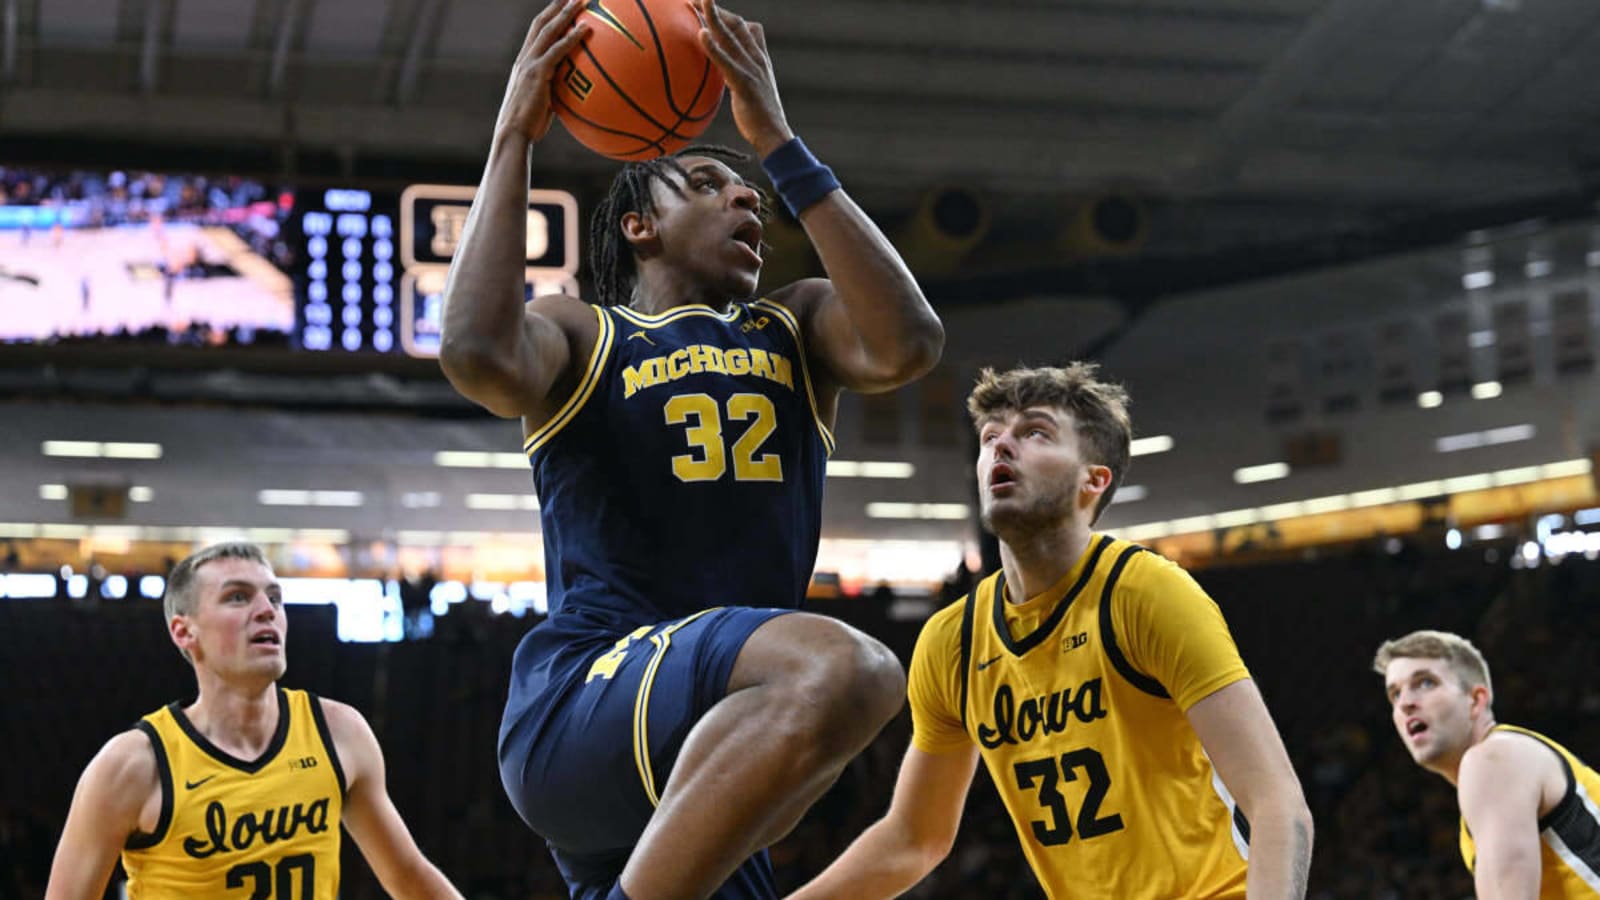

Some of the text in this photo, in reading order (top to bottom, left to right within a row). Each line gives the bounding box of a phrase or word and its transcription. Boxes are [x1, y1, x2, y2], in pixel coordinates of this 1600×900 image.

[622, 345, 794, 399] MICHIGAN
[664, 393, 783, 482] 32
[978, 677, 1107, 749] Iowa
[183, 798, 330, 859] Iowa
[1013, 747, 1125, 847] 32
